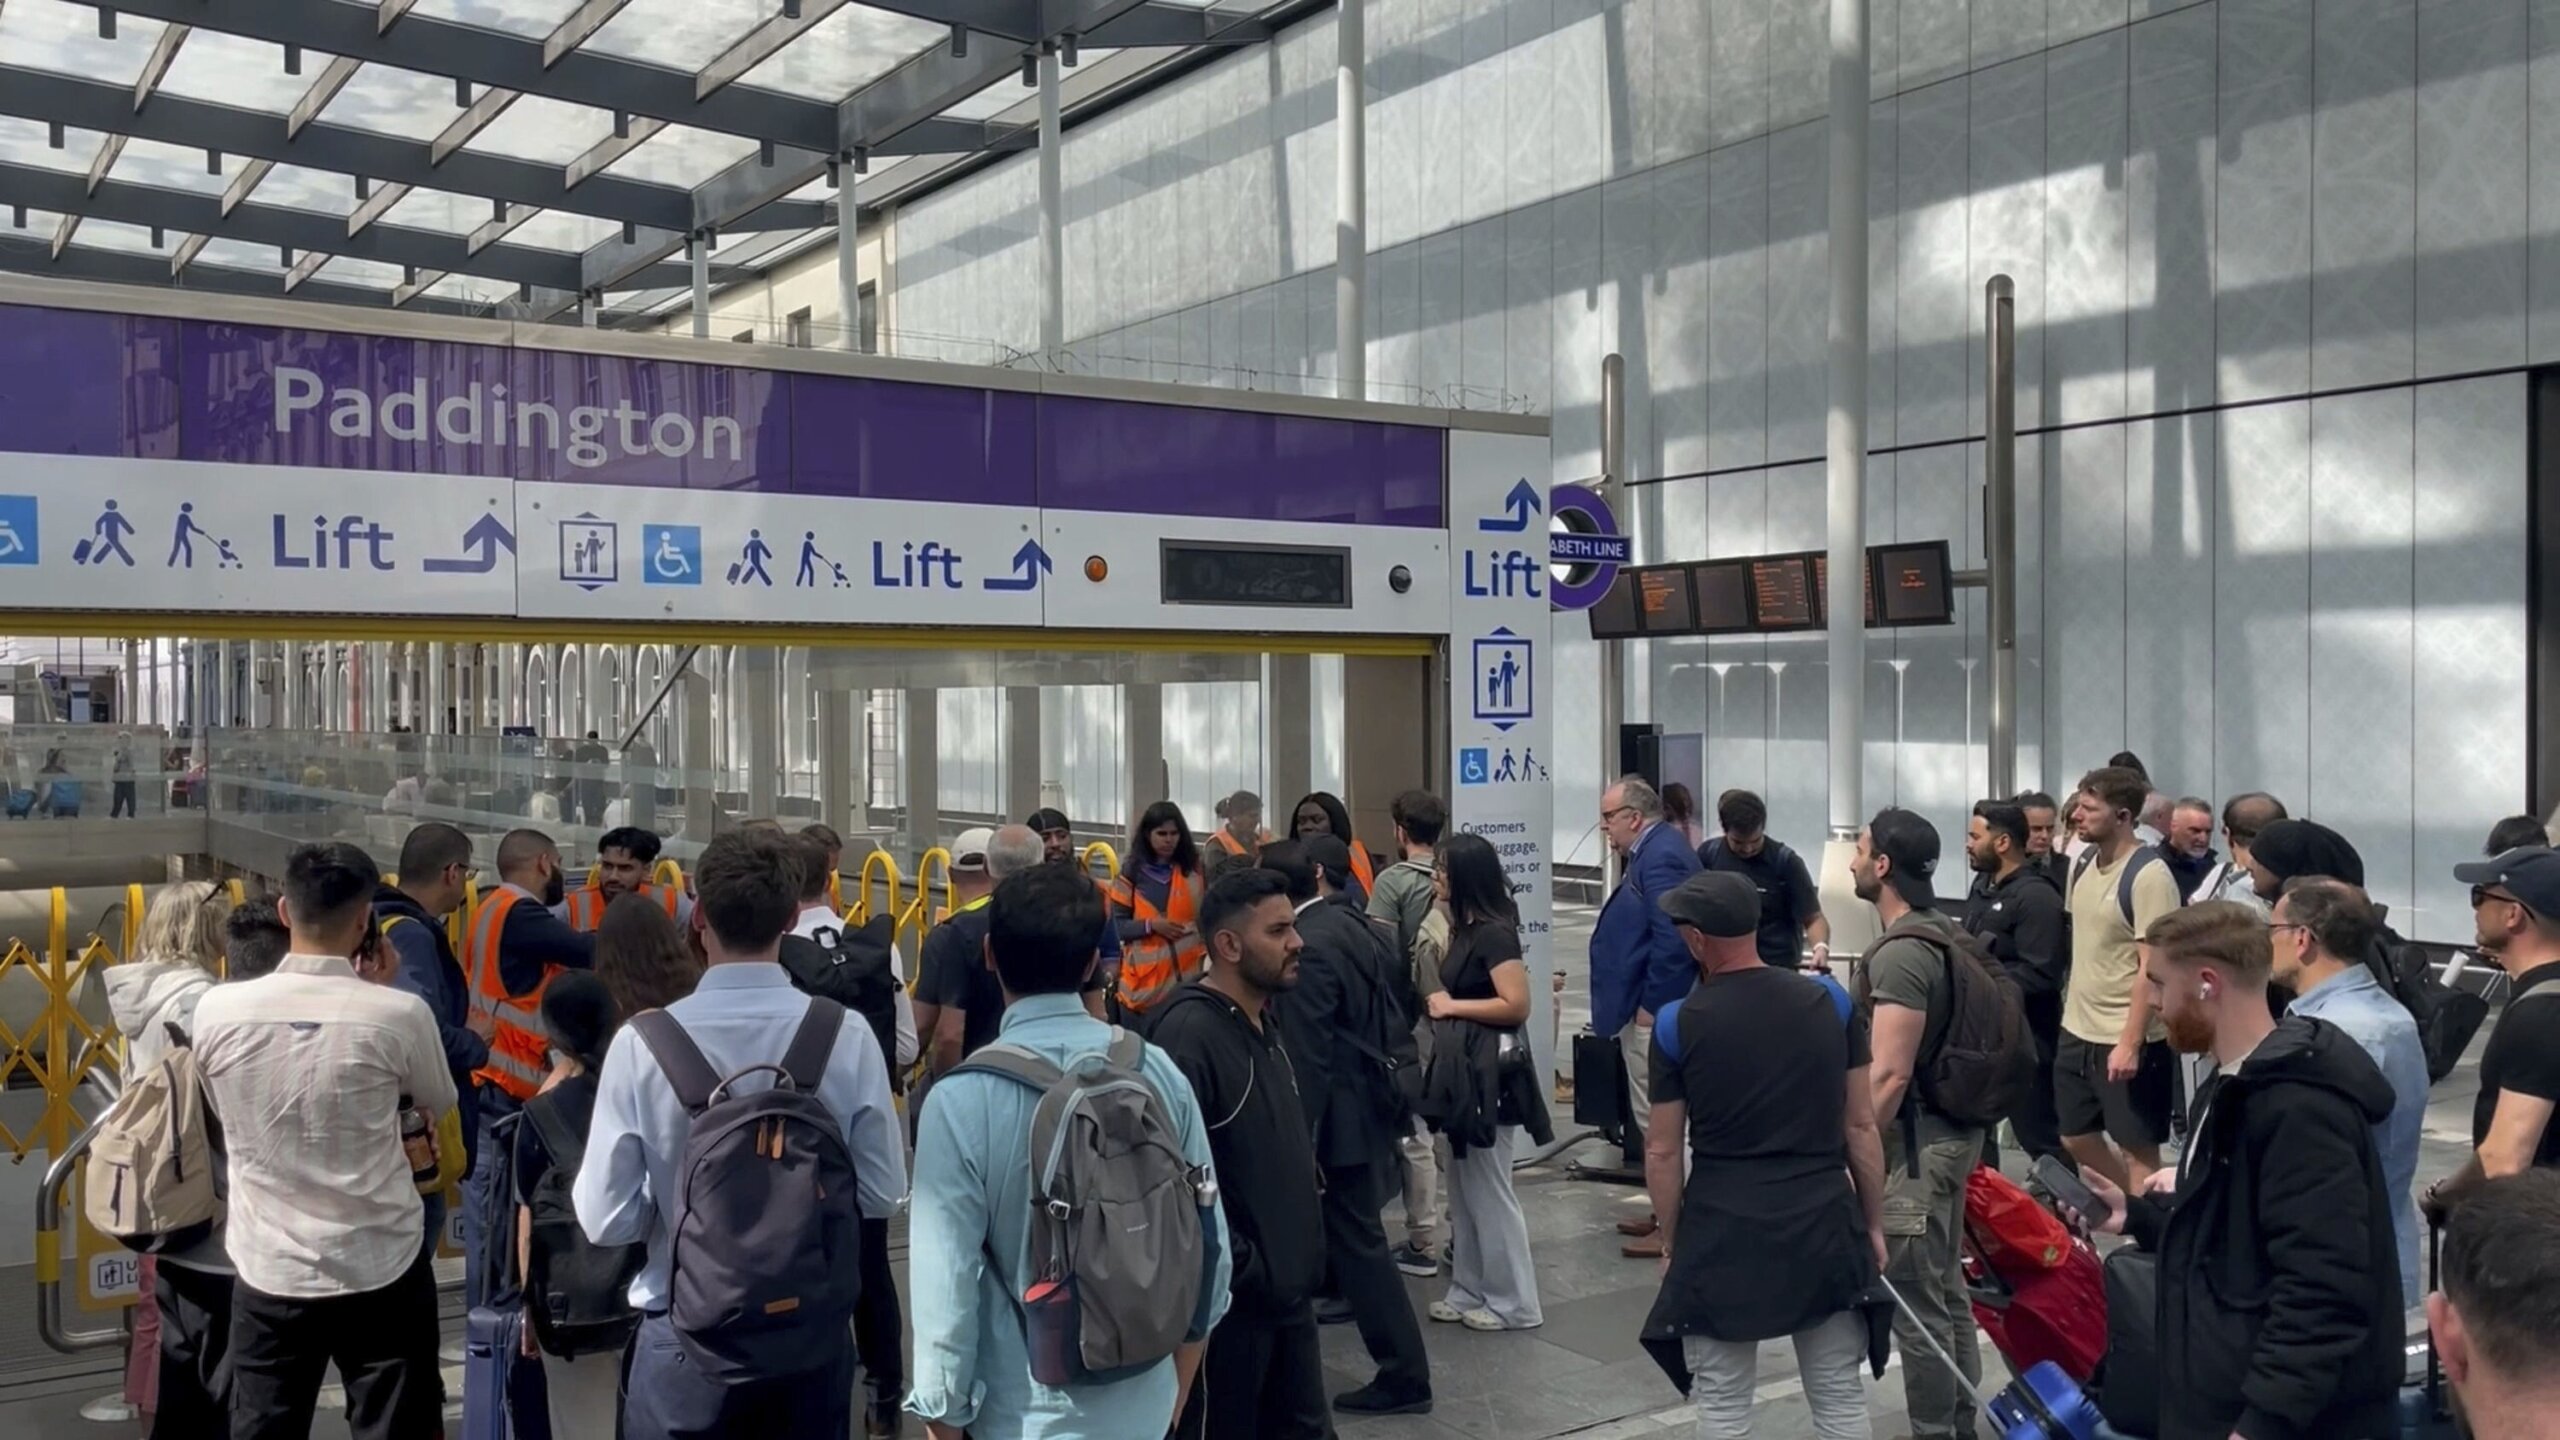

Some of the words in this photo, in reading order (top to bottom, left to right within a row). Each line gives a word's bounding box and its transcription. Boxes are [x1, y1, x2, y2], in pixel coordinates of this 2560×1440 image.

[274, 365, 742, 468] Paddington
[273, 514, 395, 570] Lift
[1550, 539, 1591, 555] ABETH
[1594, 541, 1624, 557] LINE
[873, 541, 963, 589] Lift
[1465, 549, 1542, 598] Lift
[1460, 822, 1526, 835] Customers
[1495, 842, 1540, 857] uggage,
[1528, 862, 1541, 873] or
[1529, 920, 1549, 933] the
